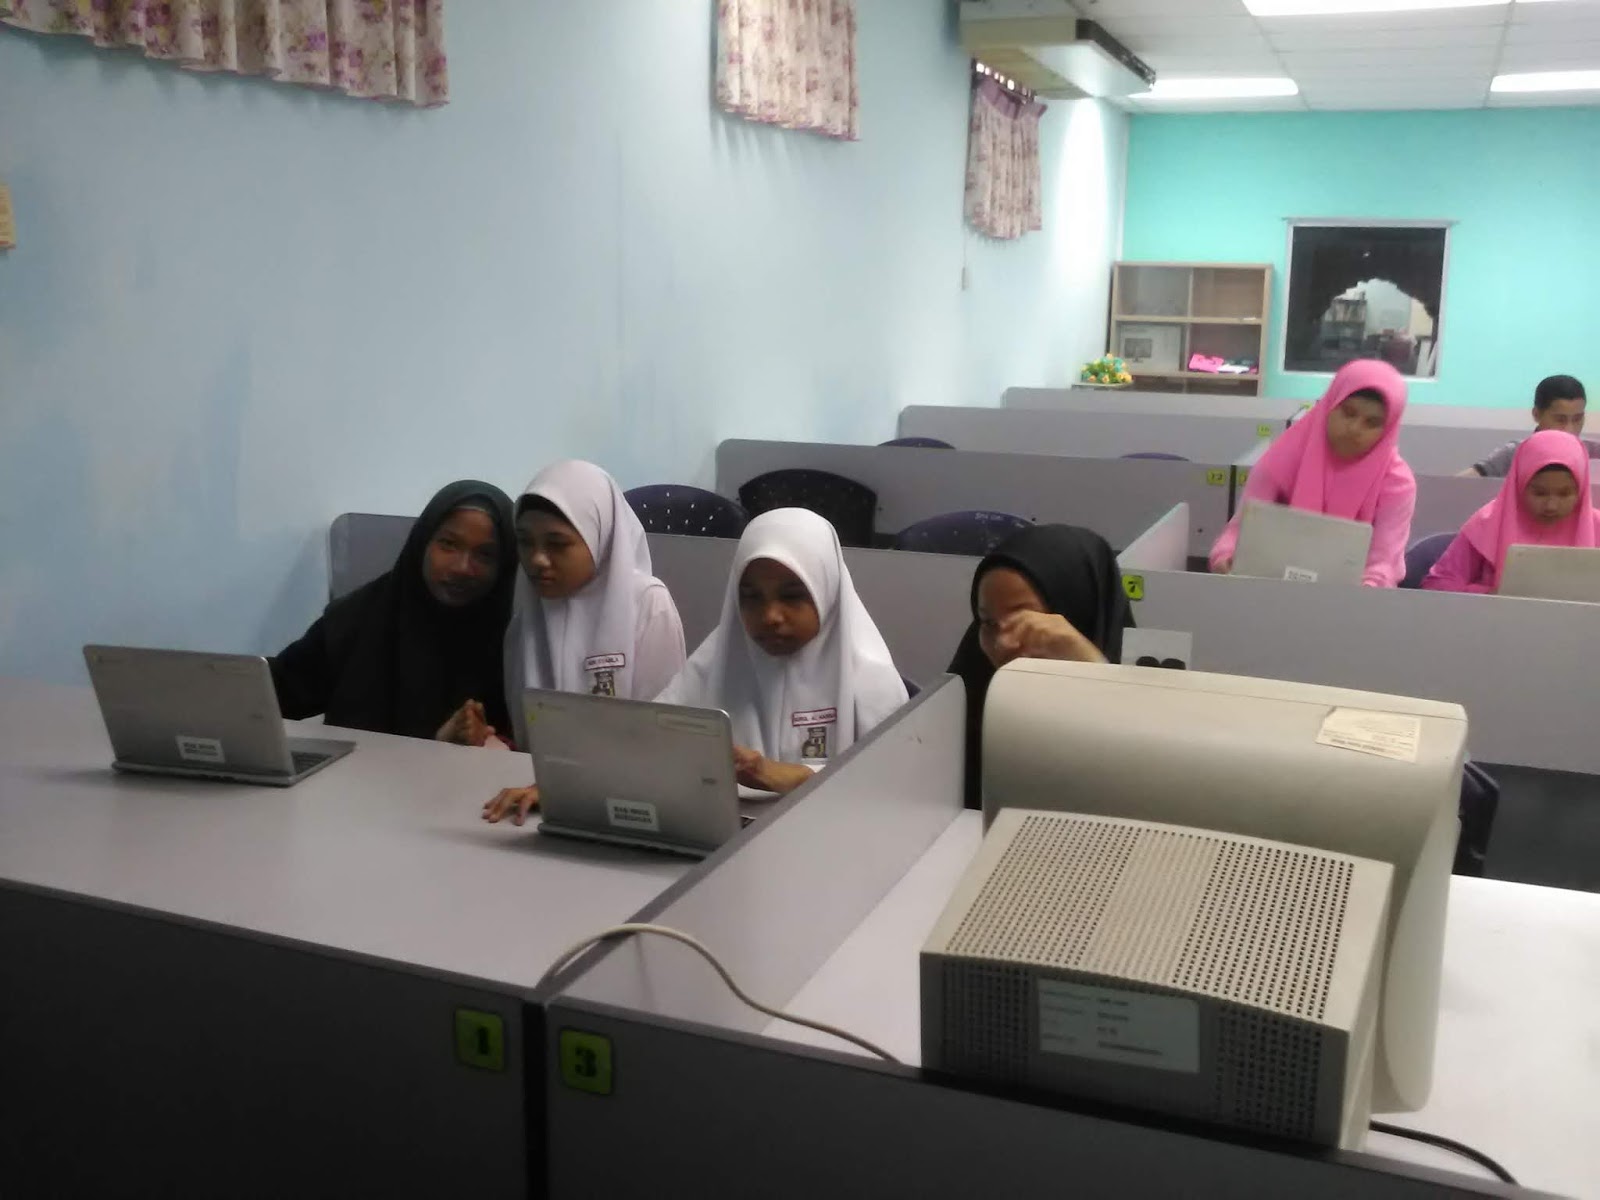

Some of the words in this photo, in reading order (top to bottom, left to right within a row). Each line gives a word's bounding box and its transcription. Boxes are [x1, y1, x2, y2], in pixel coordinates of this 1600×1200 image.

[1128, 580, 1138, 594] 7
[477, 1025, 490, 1056] 1
[574, 1046, 597, 1078] 3
